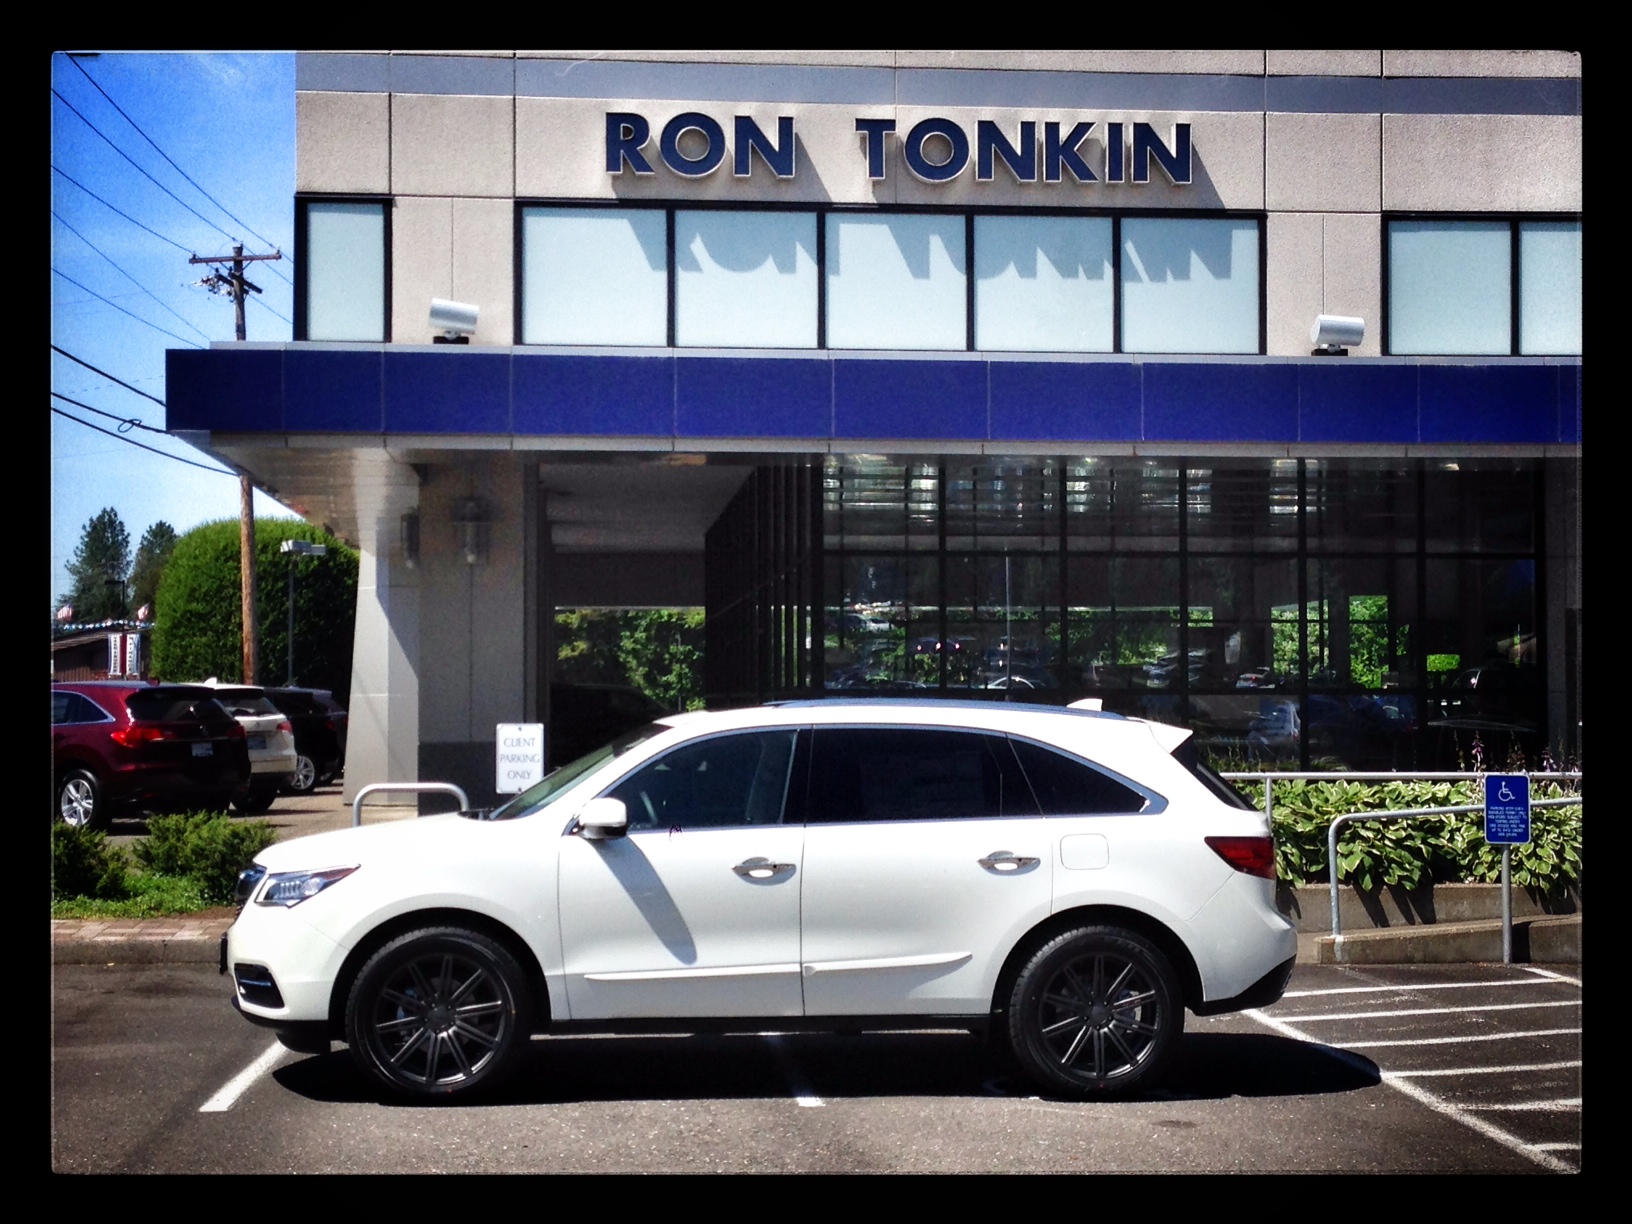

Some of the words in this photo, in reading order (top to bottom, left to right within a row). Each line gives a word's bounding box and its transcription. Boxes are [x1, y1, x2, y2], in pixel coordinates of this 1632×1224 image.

[605, 111, 796, 179] RON
[854, 117, 1193, 185] TONKIN
[503, 737, 536, 747] CLIENT
[500, 753, 540, 763] PARKING
[507, 770, 532, 780] ONLY
